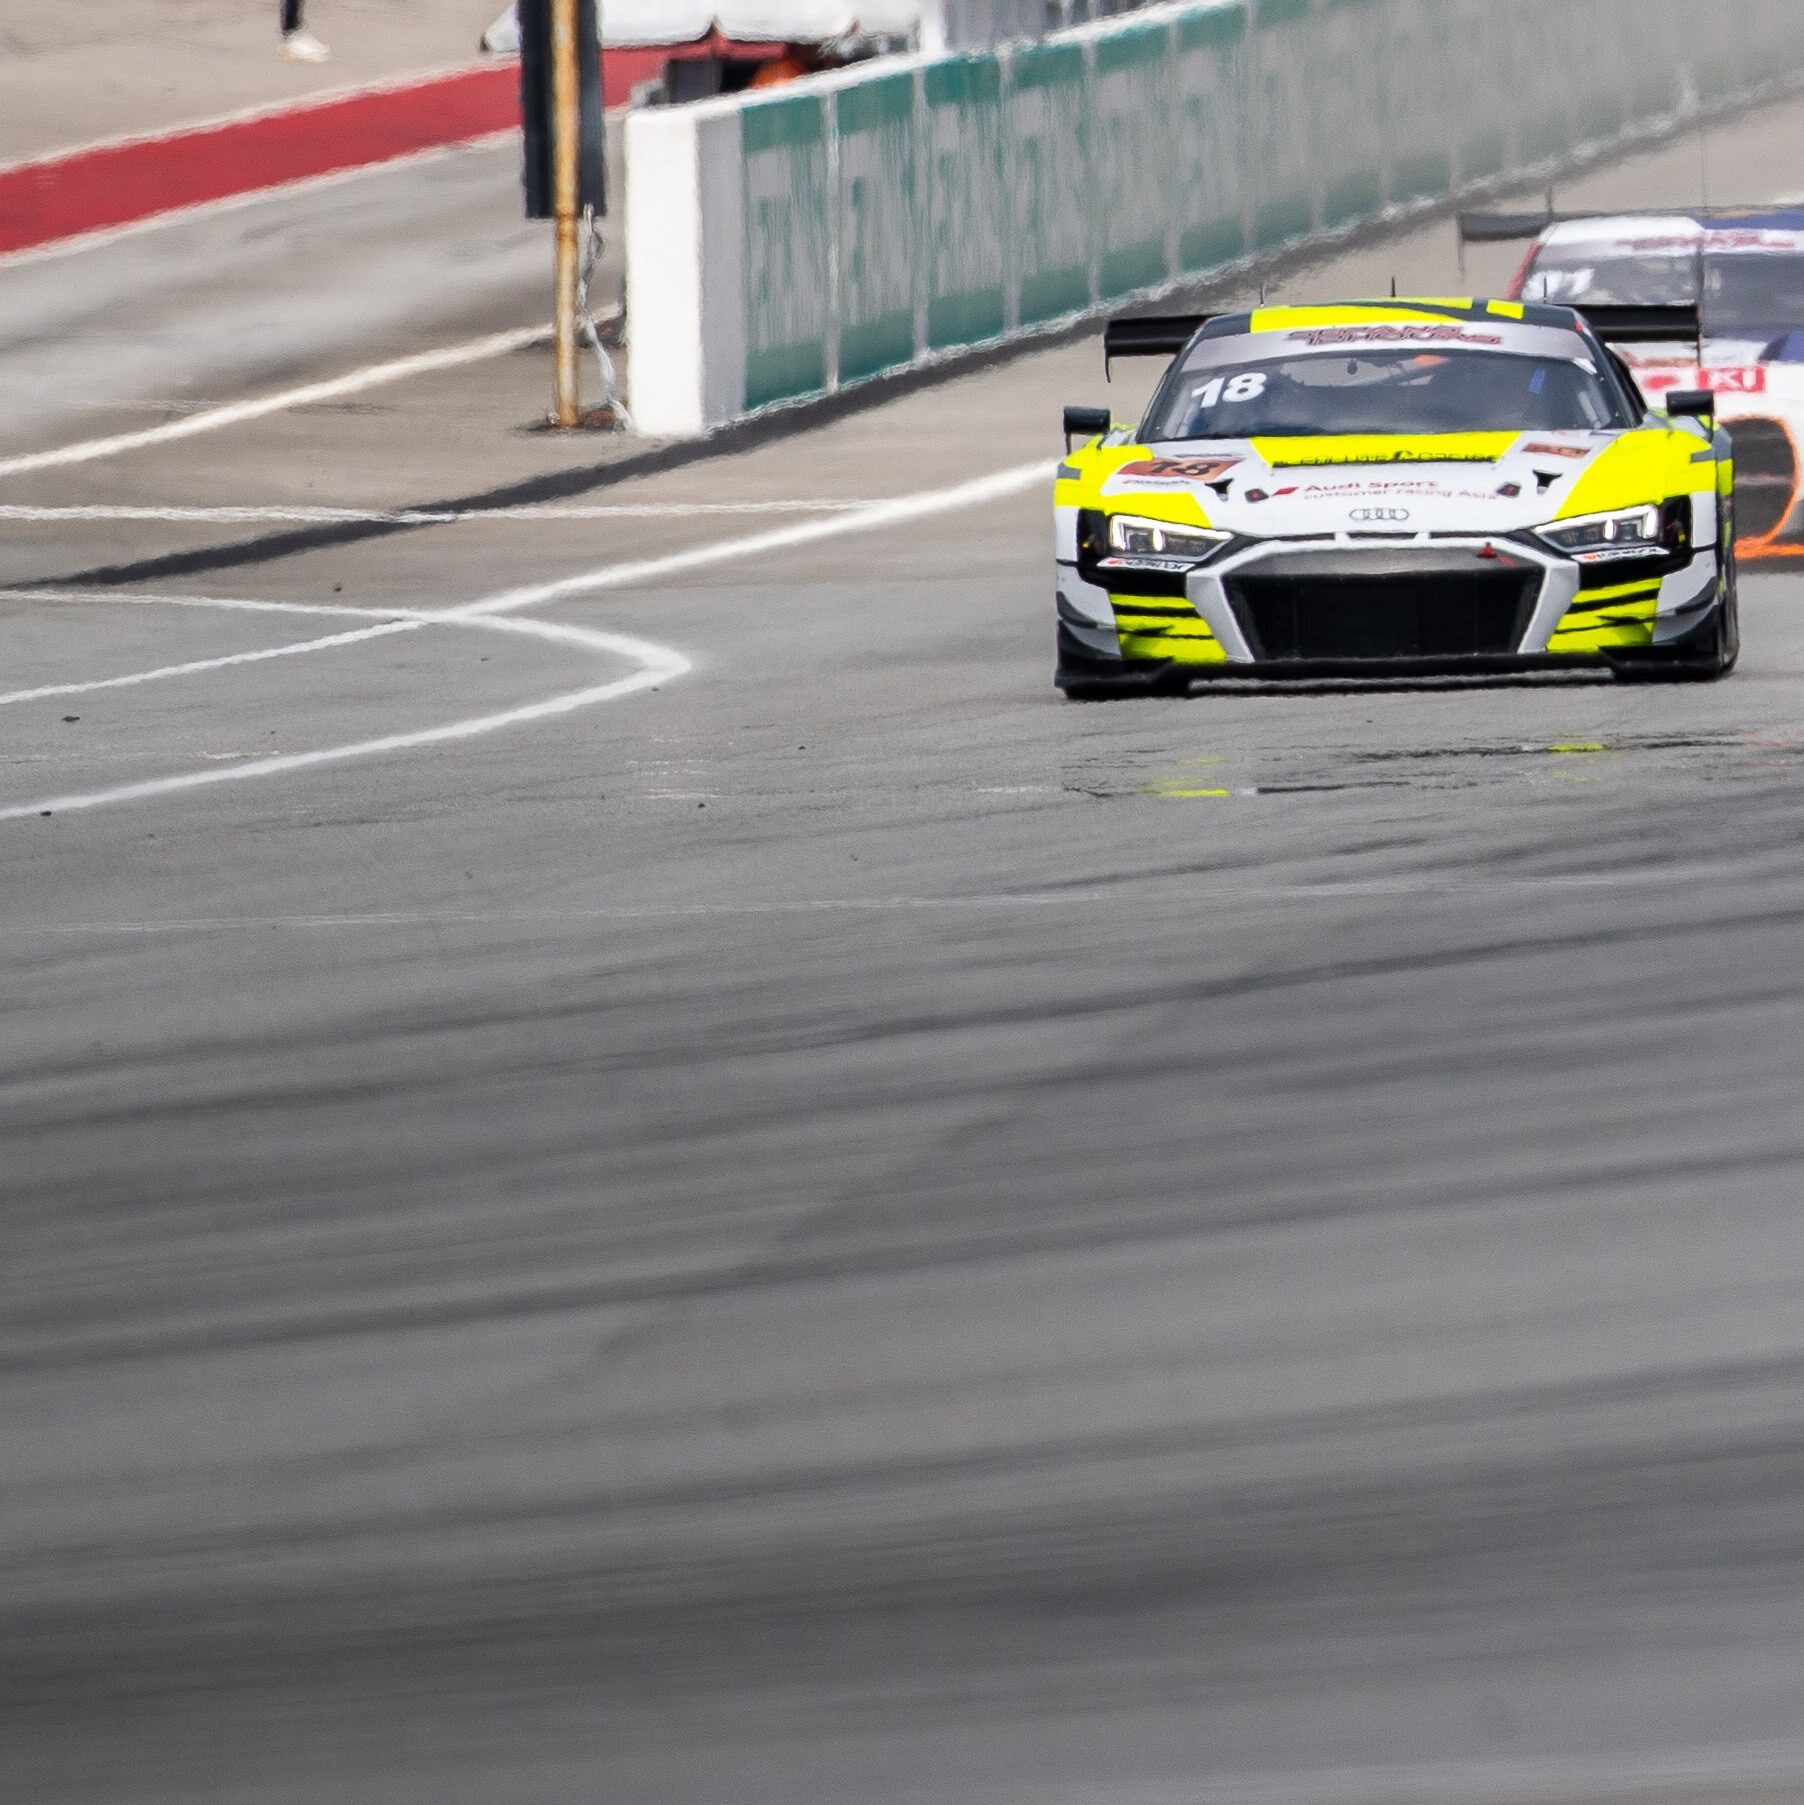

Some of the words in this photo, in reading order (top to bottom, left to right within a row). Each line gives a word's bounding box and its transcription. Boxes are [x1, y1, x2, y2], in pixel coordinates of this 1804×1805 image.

[1190, 371, 1268, 409] 18
[1304, 481, 1360, 492] Audi
[1369, 479, 1439, 489] Sport
[1304, 488, 1388, 500] customer
[1396, 487, 1451, 498] racing
[1459, 489, 1498, 500] Asia
